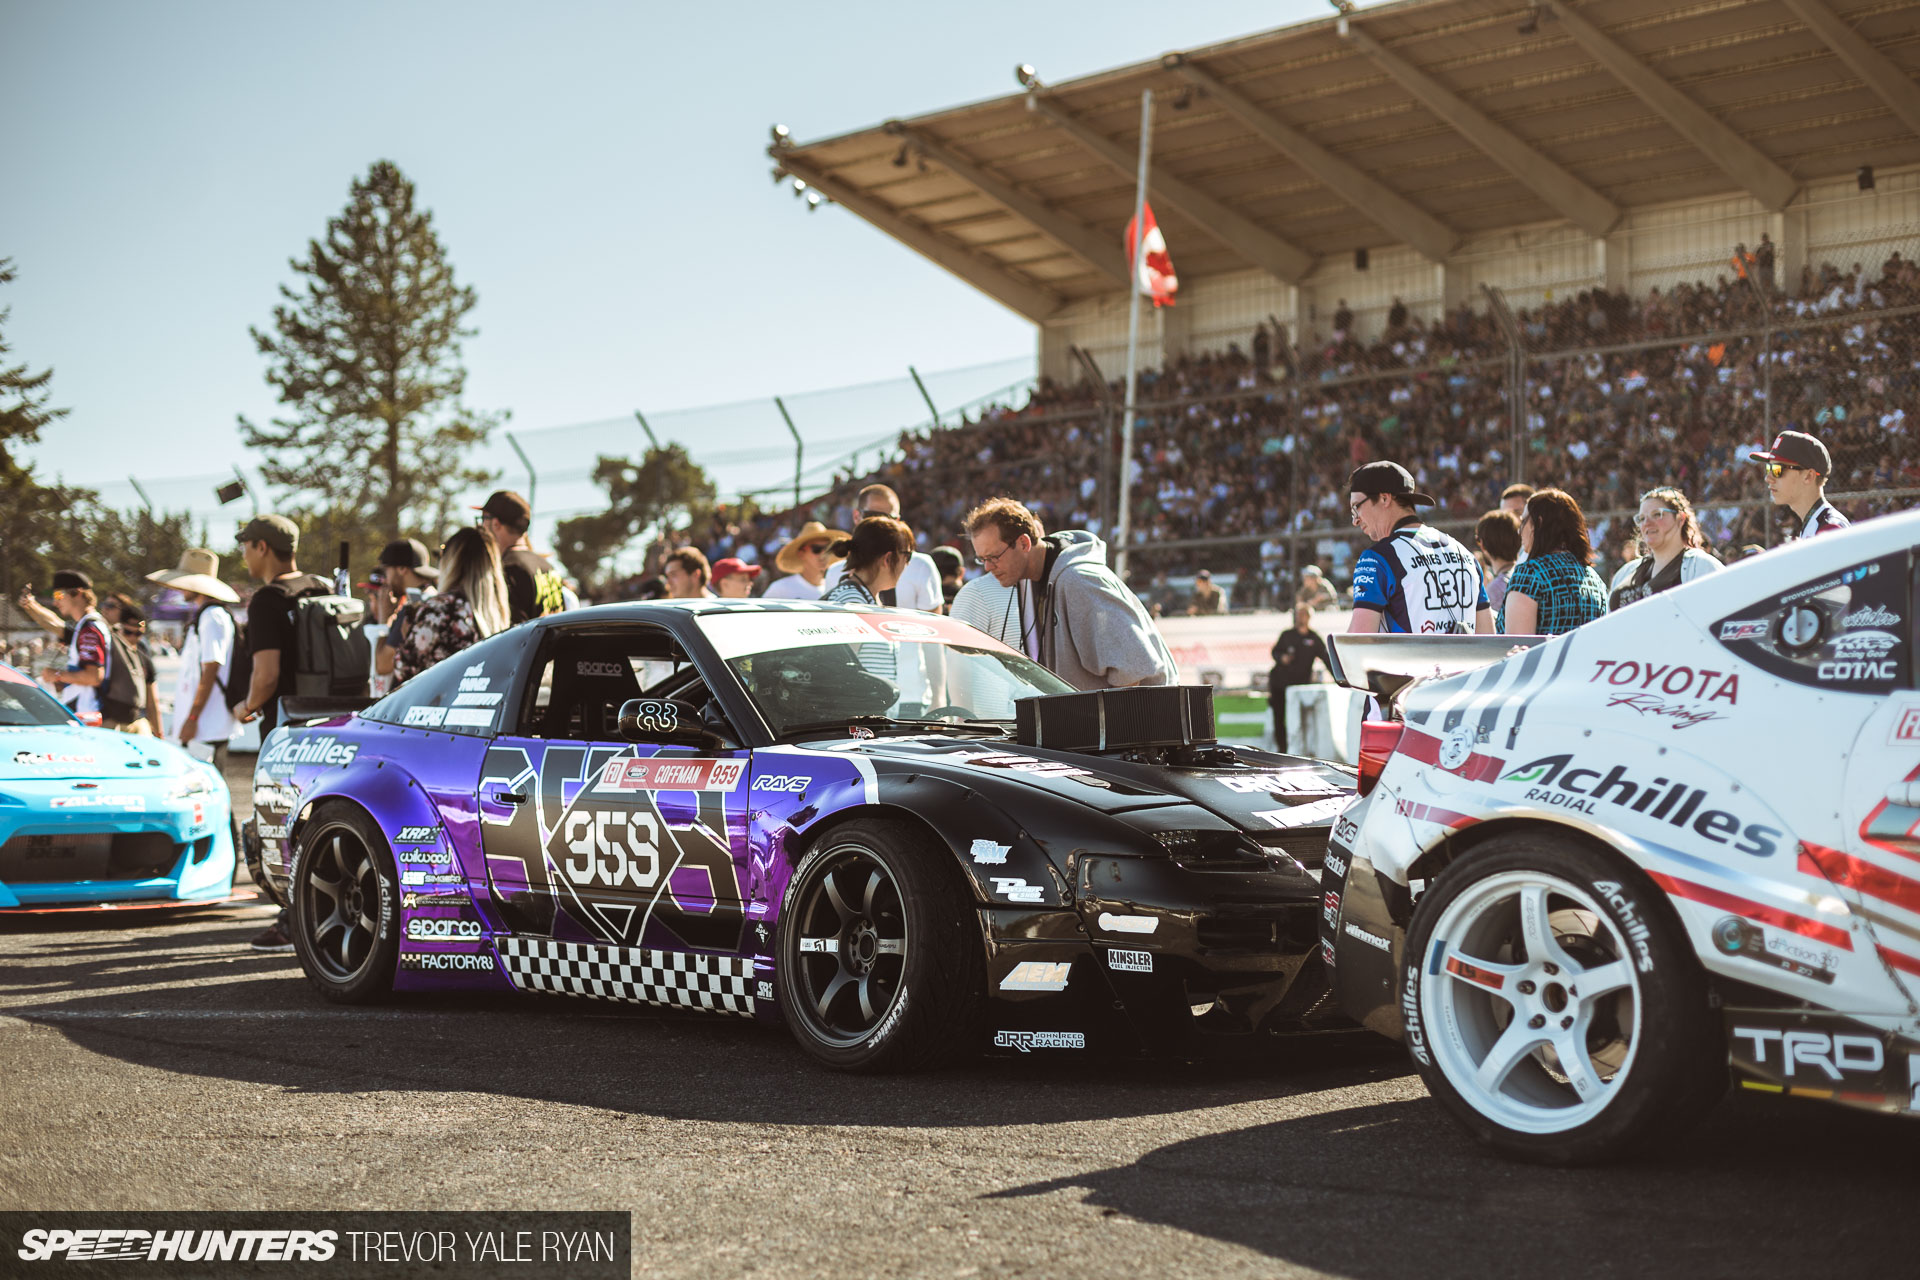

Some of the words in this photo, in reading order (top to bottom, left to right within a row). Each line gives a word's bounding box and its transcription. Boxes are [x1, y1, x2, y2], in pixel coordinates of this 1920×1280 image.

[1411, 553, 1440, 569] JAMES
[1424, 568, 1473, 610] 130
[1834, 650, 1864, 660] Racing
[1867, 650, 1889, 658] Gear
[1818, 661, 1898, 679] COTAC
[1589, 660, 1739, 705] TOYOTA
[1606, 692, 1731, 729] Racing
[263, 736, 359, 764] Achilles
[654, 765, 703, 784] COFFMAN
[711, 765, 740, 785] 959
[752, 774, 812, 792] RAYS
[1500, 754, 1784, 858] Achilles
[1524, 787, 1595, 815] RADIAL
[396, 827, 431, 840] XRP
[400, 847, 453, 864] wilwood
[564, 810, 660, 888] 959
[379, 873, 392, 940] Achilles
[408, 919, 481, 940] sparco
[1592, 879, 1654, 973] Achilles
[421, 955, 494, 970] FACTORY83
[1109, 950, 1151, 966] KINSLER
[1004, 963, 1069, 983] AEM
[1404, 965, 1430, 1066] Achilles
[995, 1031, 1035, 1052] JRR
[1035, 1039, 1084, 1048] RACING
[1734, 1027, 1885, 1080] TRD
